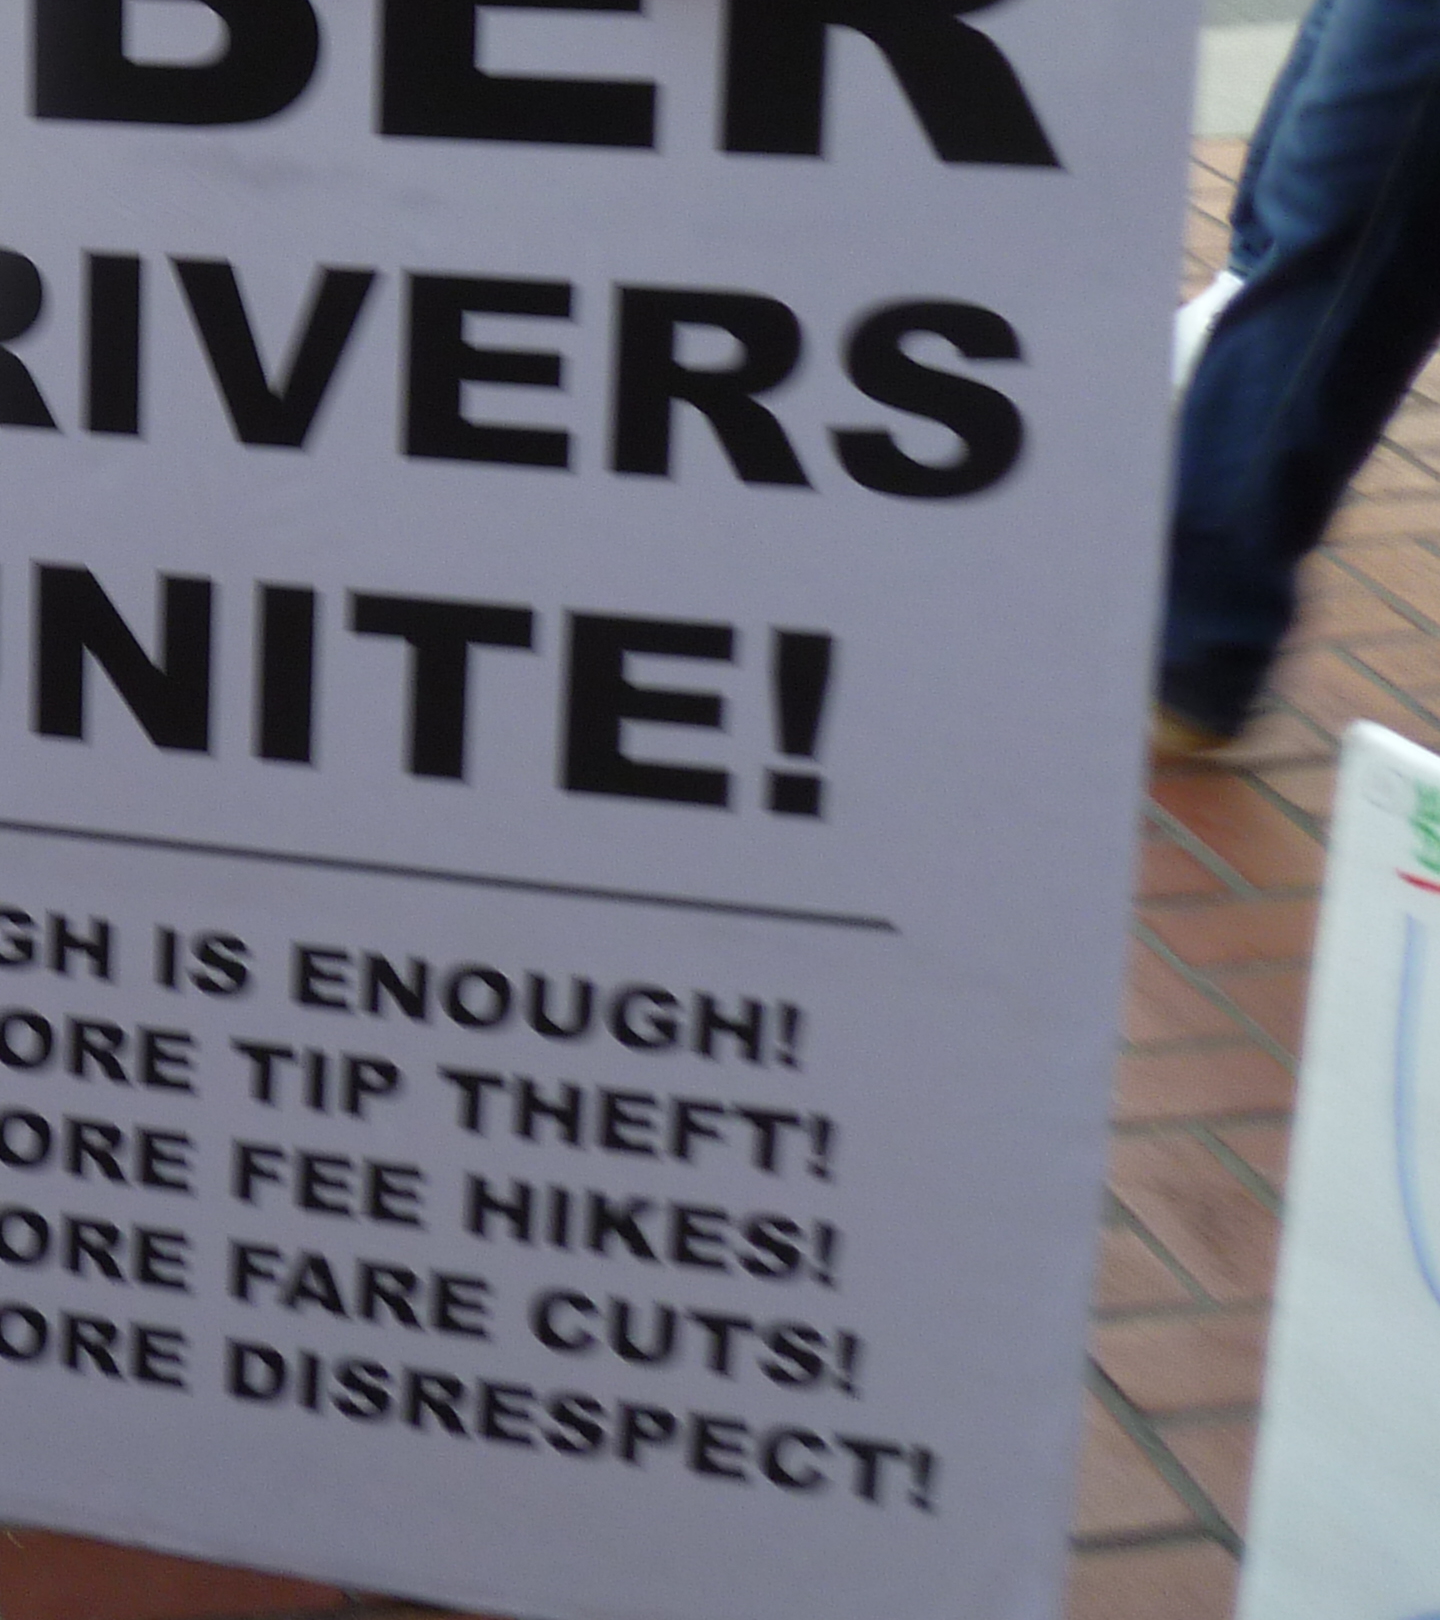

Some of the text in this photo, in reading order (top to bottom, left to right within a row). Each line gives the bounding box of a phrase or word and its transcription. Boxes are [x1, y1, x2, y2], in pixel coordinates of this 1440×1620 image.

[154, 925, 253, 1001] IS
[290, 941, 805, 1070] ENOUGH!
[230, 1037, 405, 1121] TIP
[437, 1064, 836, 1183] THEFT!
[230, 1138, 426, 1232] FEE
[462, 1171, 840, 1290] HIKES!
[226, 1238, 492, 1344] FARE
[527, 1286, 863, 1400] CUTS!
[223, 1336, 939, 1513] DISRESPECT!
